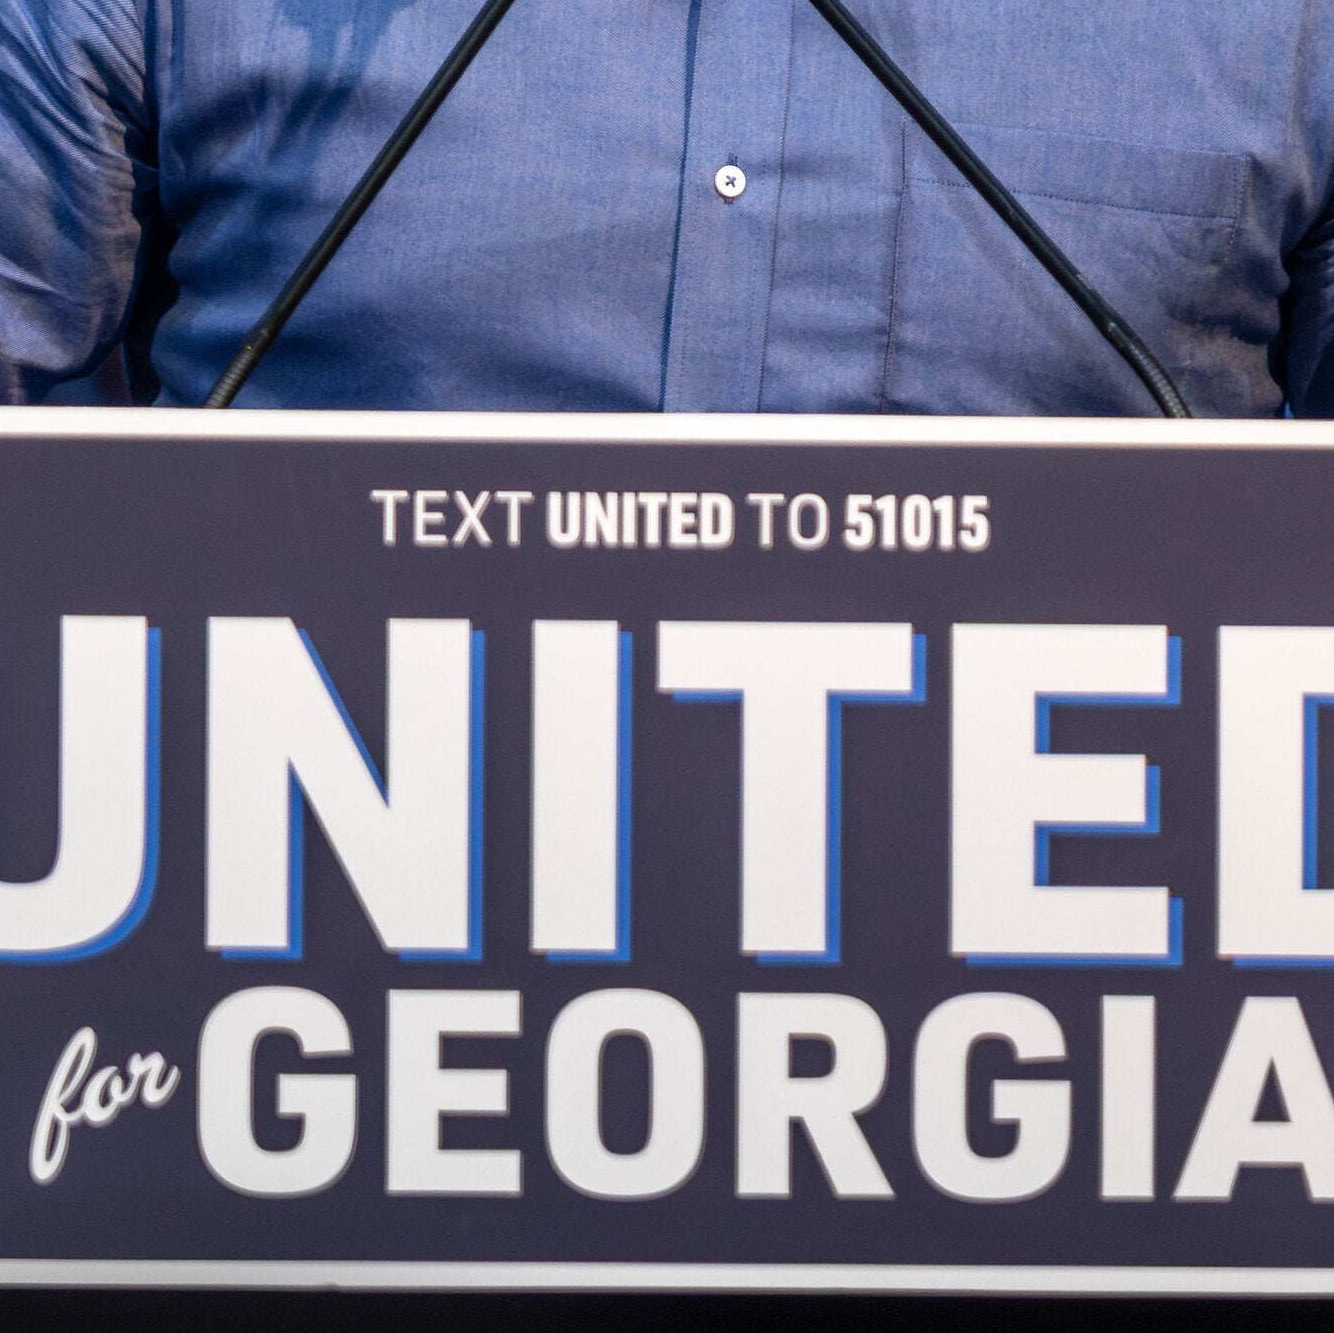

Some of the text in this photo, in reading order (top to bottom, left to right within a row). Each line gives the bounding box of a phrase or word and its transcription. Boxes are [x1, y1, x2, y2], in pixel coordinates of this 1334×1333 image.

[370, 489, 990, 551] TEXT UNITED TO 51015
[30, 1025, 180, 1184] for
